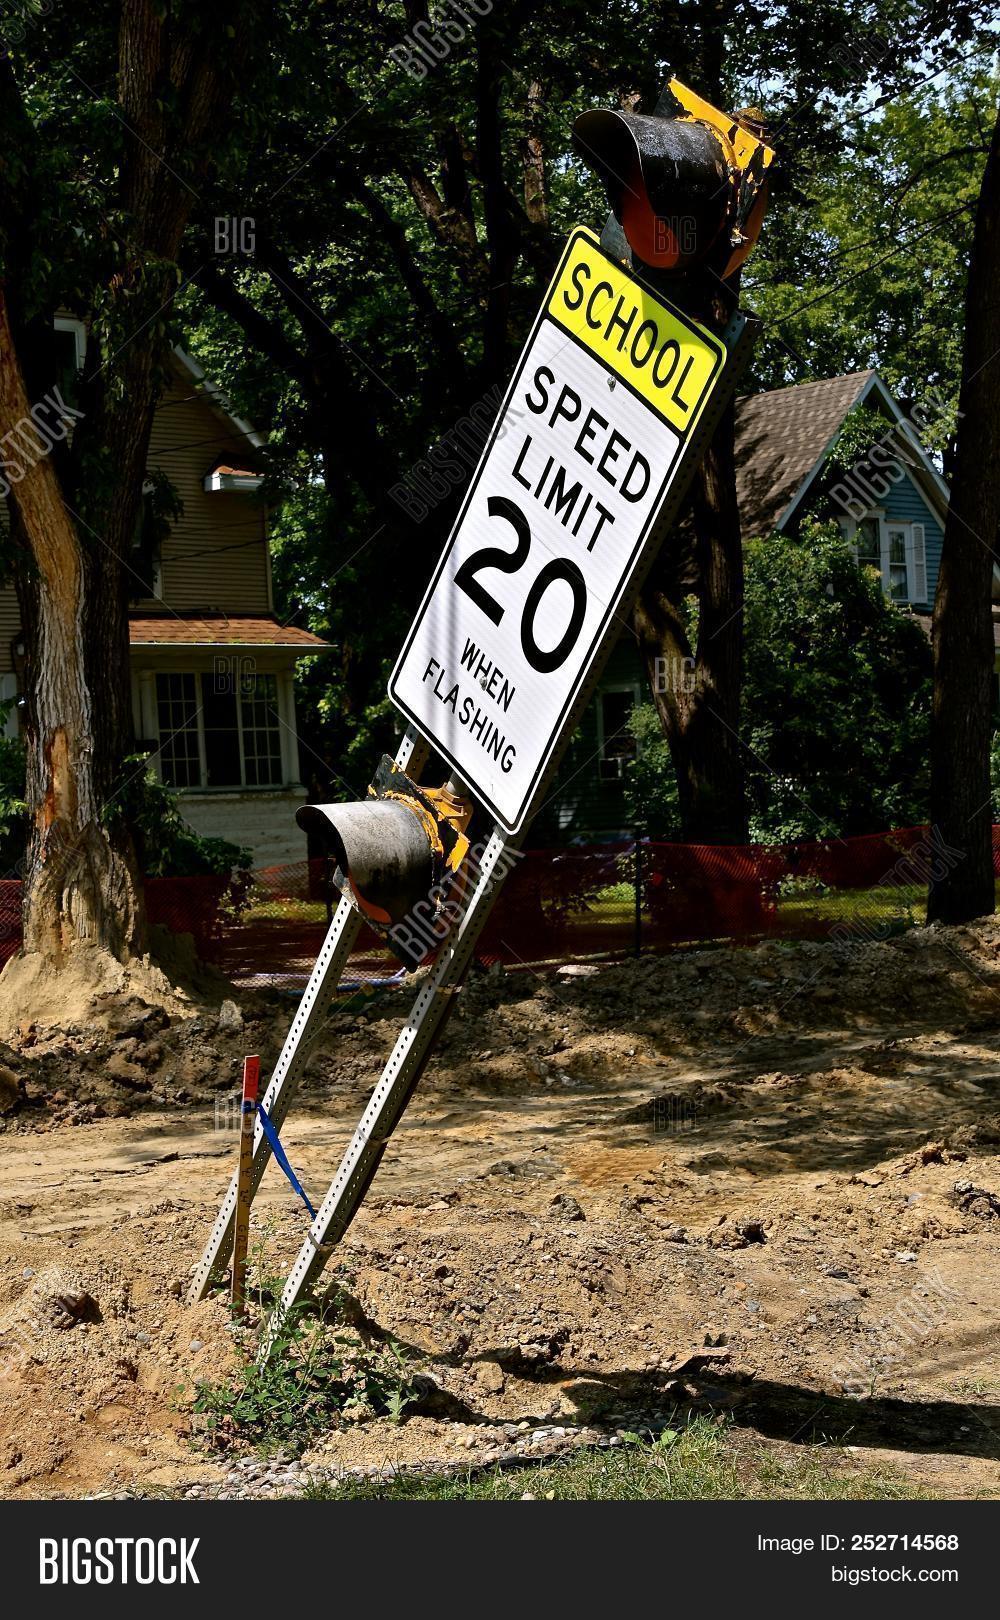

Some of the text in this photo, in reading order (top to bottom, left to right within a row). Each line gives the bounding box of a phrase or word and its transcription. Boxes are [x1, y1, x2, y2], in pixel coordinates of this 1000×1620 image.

[563, 262, 695, 414] SCHOOL
[511, 434, 616, 553] LIMIT
[525, 366, 651, 503] SPEED
[453, 495, 588, 674] 20
[422, 657, 517, 774] FLASHING
[460, 637, 516, 713] WHEN
